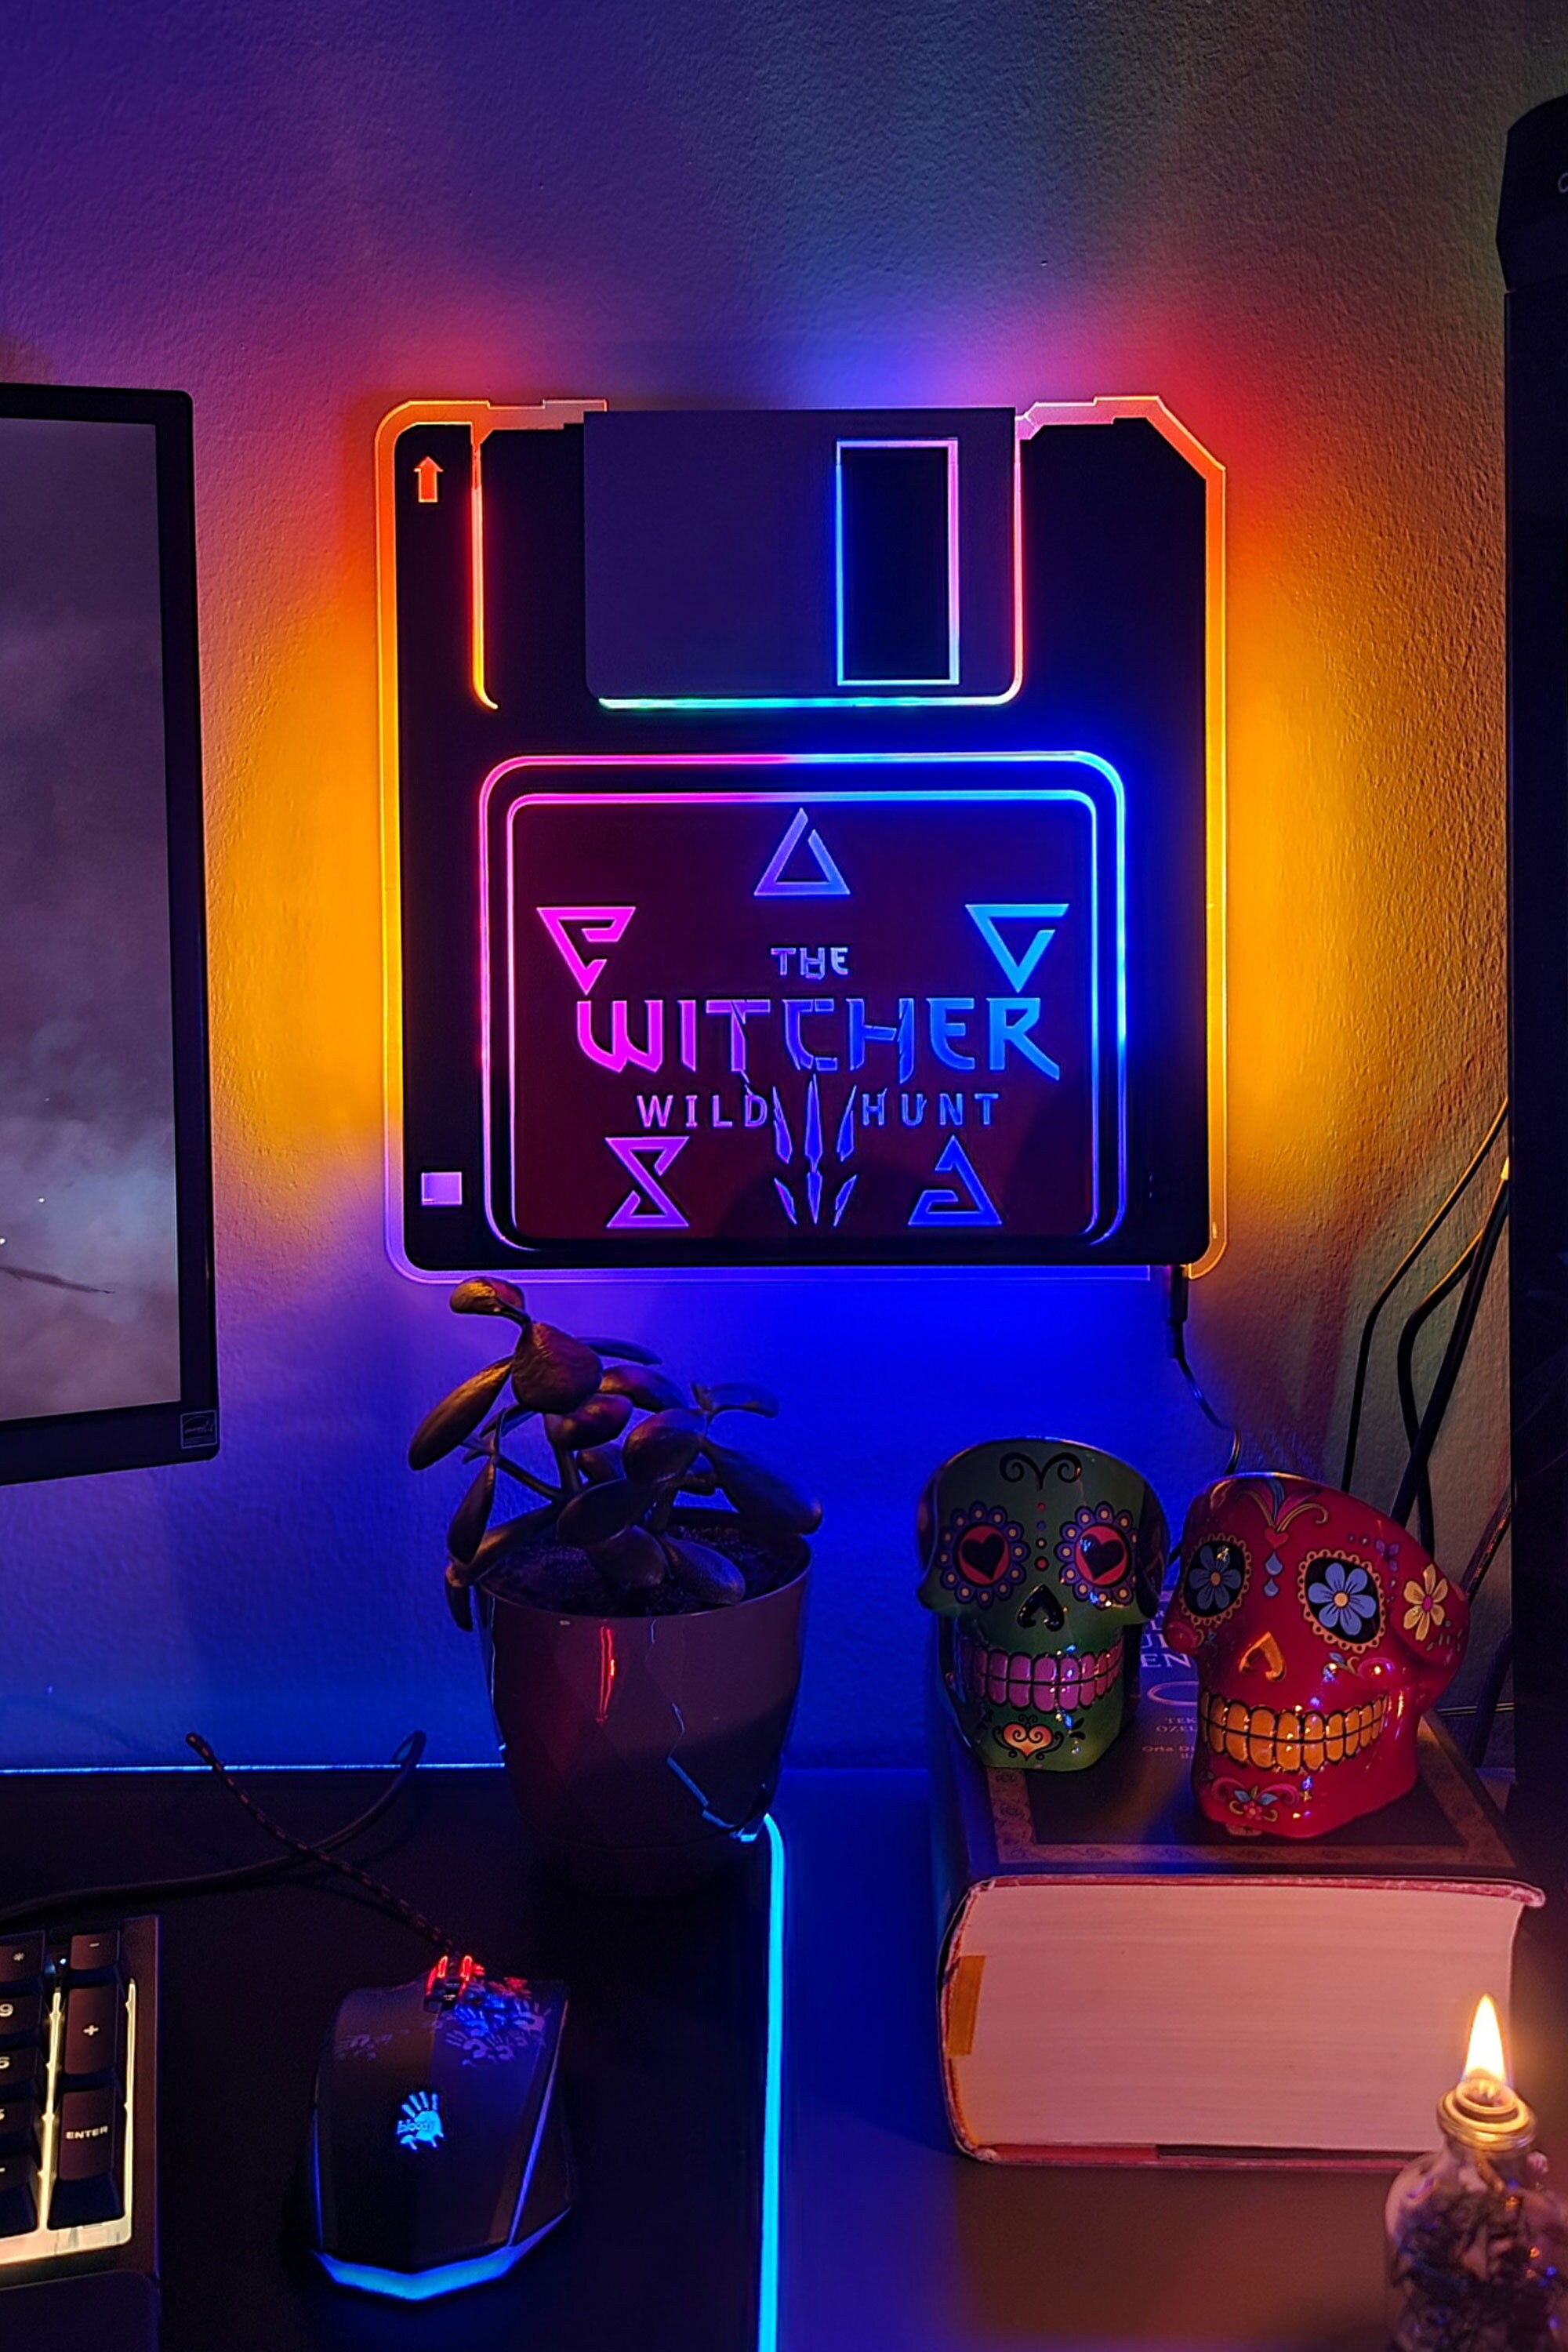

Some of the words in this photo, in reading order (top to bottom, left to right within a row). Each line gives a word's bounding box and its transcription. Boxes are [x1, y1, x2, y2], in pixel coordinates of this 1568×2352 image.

[771, 947, 849, 980] THE
[577, 997, 1060, 1084] WITCHER
[636, 1094, 768, 1127] WILD
[862, 1088, 1000, 1127] HUNT
[66, 2125, 109, 2140] ENTER
